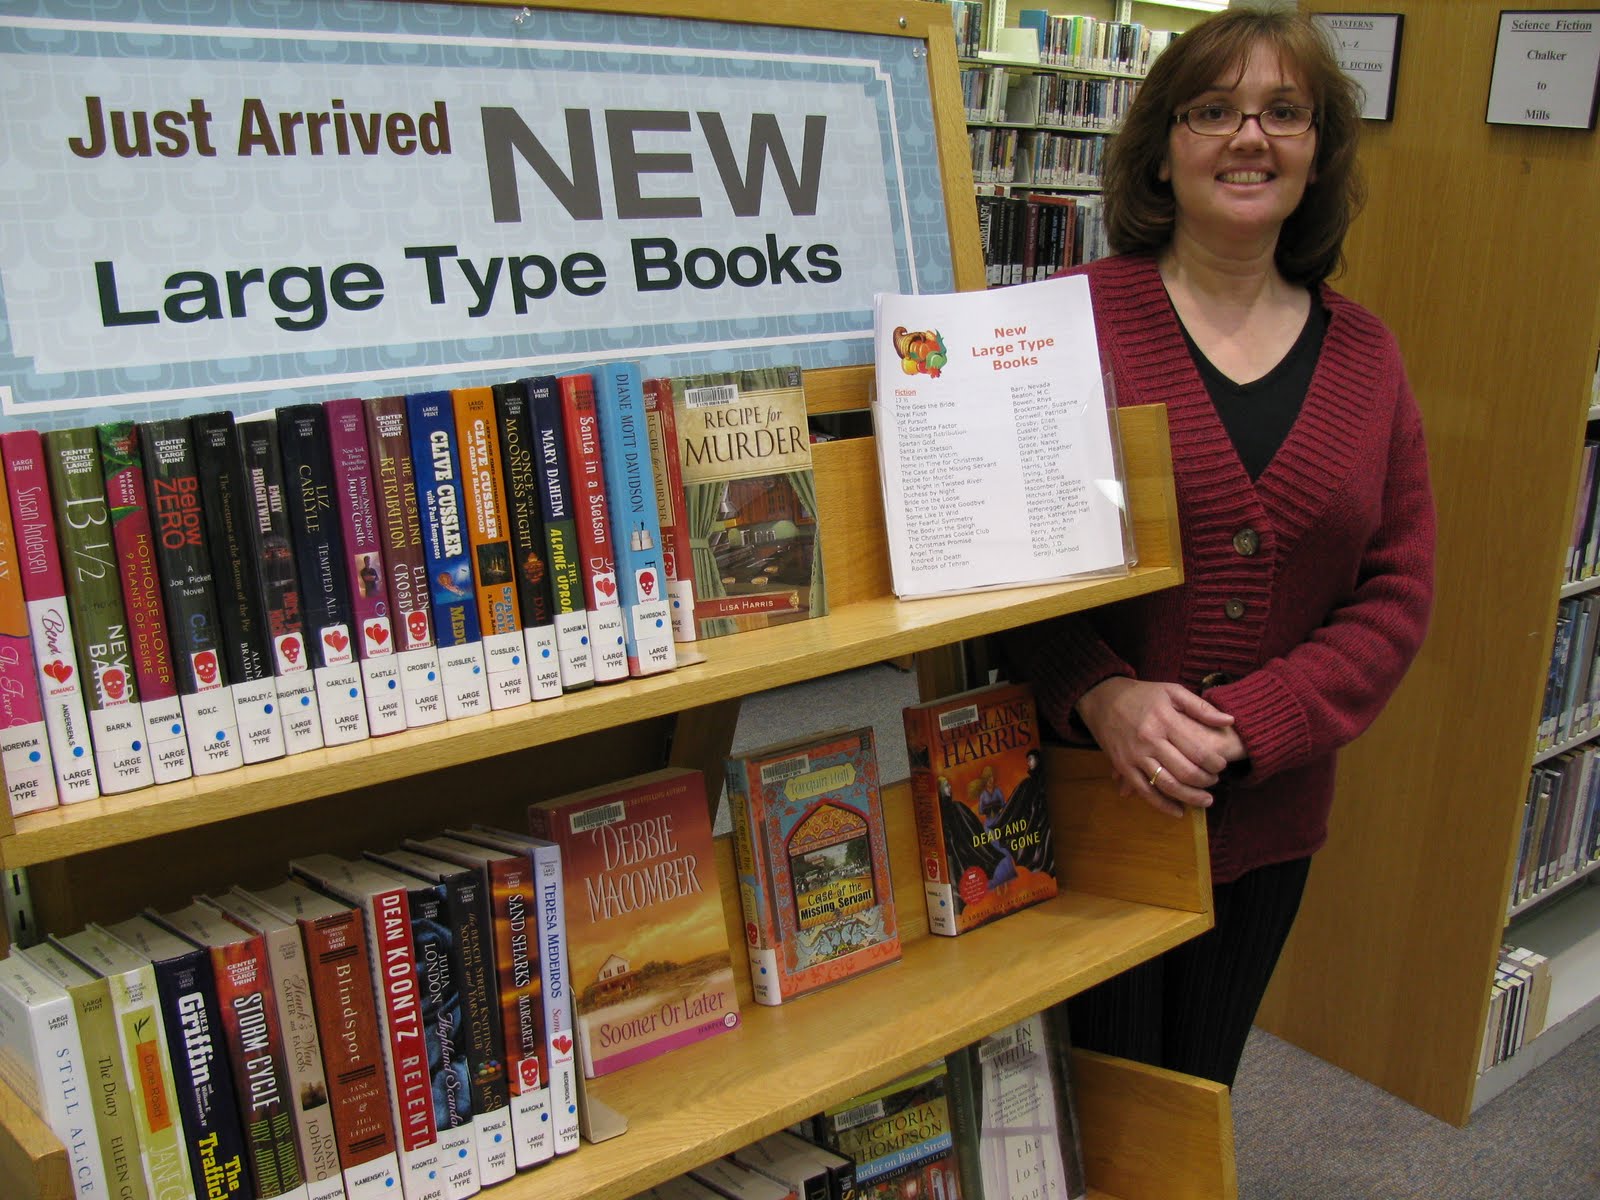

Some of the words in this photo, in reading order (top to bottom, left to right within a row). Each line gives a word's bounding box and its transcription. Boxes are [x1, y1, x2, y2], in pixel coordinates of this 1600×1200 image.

[1332, 20, 1374, 29] WESTERNS
[1512, 19, 1550, 31] Science
[1556, 20, 1592, 31] Fiction
[1350, 61, 1383, 71] FICTION
[1527, 50, 1567, 61] Chalker
[1537, 81, 1546, 91] to
[1524, 109, 1550, 120] Mills
[68, 96, 217, 158] Just
[238, 98, 452, 156] Arrived
[480, 106, 827, 223] NEW
[94, 260, 385, 331] Large
[404, 245, 607, 318] Type
[630, 233, 842, 292] Books
[972, 342, 1014, 357] Large
[1018, 337, 1055, 351] Type
[994, 325, 1027, 338] New
[993, 357, 1038, 371] Books
[616, 374, 632, 411] DIANE
[895, 389, 916, 397] Fiction
[621, 415, 636, 448] MOTT
[704, 406, 762, 429] RECIPE
[766, 405, 782, 428] for
[154, 438, 186, 446] CENTER
[473, 419, 488, 467] CLIVE
[541, 429, 557, 466] MARY
[579, 416, 594, 454] Santa
[685, 425, 807, 467] MURDER
[61, 448, 93, 457] CENTER
[66, 461, 93, 469] LARGE
[401, 457, 411, 477] THE
[430, 430, 453, 482] CLIVE
[469, 446, 478, 476] GRANT
[585, 461, 598, 474] in
[506, 418, 526, 498] MOONLESS
[516, 502, 532, 549] NIGHT
[521, 450, 534, 490] ONCE
[625, 452, 644, 513] DAVIDSON
[17, 487, 41, 521] Susan
[119, 475, 128, 503] BERWIN
[126, 472, 137, 505] MARGOT
[252, 468, 272, 534] BRIGHTWELL
[269, 485, 283, 513] EMILY
[299, 465, 319, 534] CARLYLE
[316, 485, 330, 510] LIZ
[380, 457, 405, 549] RETRIBUTION
[473, 477, 485, 533] BLACKWOOD
[479, 471, 498, 539] CUSSLER
[546, 468, 564, 518] DAHEIM
[153, 479, 186, 549] ZERO
[177, 476, 202, 545] Below
[437, 484, 462, 559] CUSSLER
[589, 495, 606, 544] Stetson
[23, 522, 48, 574] Andersen
[431, 523, 441, 560] Kemprecos
[550, 529, 567, 571] ALPINE
[170, 579, 184, 587] Joe
[189, 574, 212, 584] Pickett
[318, 543, 334, 593] TEMPTED
[567, 562, 577, 585] THE
[183, 587, 204, 597] Novel
[720, 602, 739, 612] LISA
[742, 600, 774, 609] HARRIS
[128, 564, 142, 608] PLANTS
[138, 635, 152, 674] DESIRE
[136, 534, 158, 617] HOTHOUSE
[151, 623, 169, 684] FLOWER
[652, 654, 667, 662] TYPE
[249, 728, 271, 738] LARGE
[335, 715, 359, 725] LARGE
[159, 749, 185, 761] LARGE
[253, 737, 270, 745] TYPE
[942, 719, 1033, 769] HARRIS
[63, 769, 92, 781] LARGE
[113, 757, 142, 769] LARGE
[119, 767, 140, 777] TYPE
[164, 759, 184, 769] TYPE
[9, 780, 38, 792] LARGE
[14, 790, 37, 801] TYPE
[69, 779, 91, 789] TYPE
[592, 814, 678, 871] DEBBIE
[972, 828, 1001, 849] DEAD
[1005, 819, 1027, 837] AND
[1010, 832, 1041, 851] GONE
[584, 854, 704, 924] MACOMBER
[800, 904, 836, 920] Missing
[838, 890, 872, 909] Servant
[807, 890, 833, 906] Case
[382, 895, 405, 941] DEAN
[509, 894, 526, 932] SAND
[544, 882, 557, 931] TERESA
[459, 925, 473, 968] SOCIETY
[512, 934, 531, 988] SHARKS
[424, 943, 442, 1004] LONDON
[437, 953, 450, 989] JULIA
[548, 934, 562, 999] MEDEIROS
[386, 946, 420, 1043] KOONTZ
[476, 967, 488, 1005] STREET
[48, 1014, 68, 1025] LARGE
[233, 992, 269, 1053] STORM
[336, 963, 361, 1063] Blindspot
[518, 995, 535, 1054] MARGARET
[600, 1017, 658, 1048] Sooner
[661, 1004, 681, 1028] Or
[684, 990, 726, 1020] Later
[178, 991, 213, 1086] Griffin
[992, 1040, 1034, 1069] WHITE
[98, 1055, 114, 1079] The
[247, 1054, 281, 1111] CYCLE
[104, 1082, 118, 1118] Diary
[342, 1089, 379, 1105] KAMENSKY
[527, 1133, 545, 1143] LARGE
[851, 1120, 943, 1164] THOMPSON
[853, 1105, 936, 1146] VICTORIA
[111, 1136, 129, 1183] EILEEN
[323, 1134, 336, 1169] JOAN
[530, 1141, 543, 1149] TYPE
[884, 1158, 897, 1168] on
[899, 1149, 920, 1164] Bank
[921, 1138, 950, 1156] Street
[1017, 1139, 1040, 1158] the
[225, 1155, 242, 1192] The
[449, 1170, 472, 1182] LARGE
[454, 1178, 471, 1188] TYPE
[1016, 1160, 1045, 1183] lost
